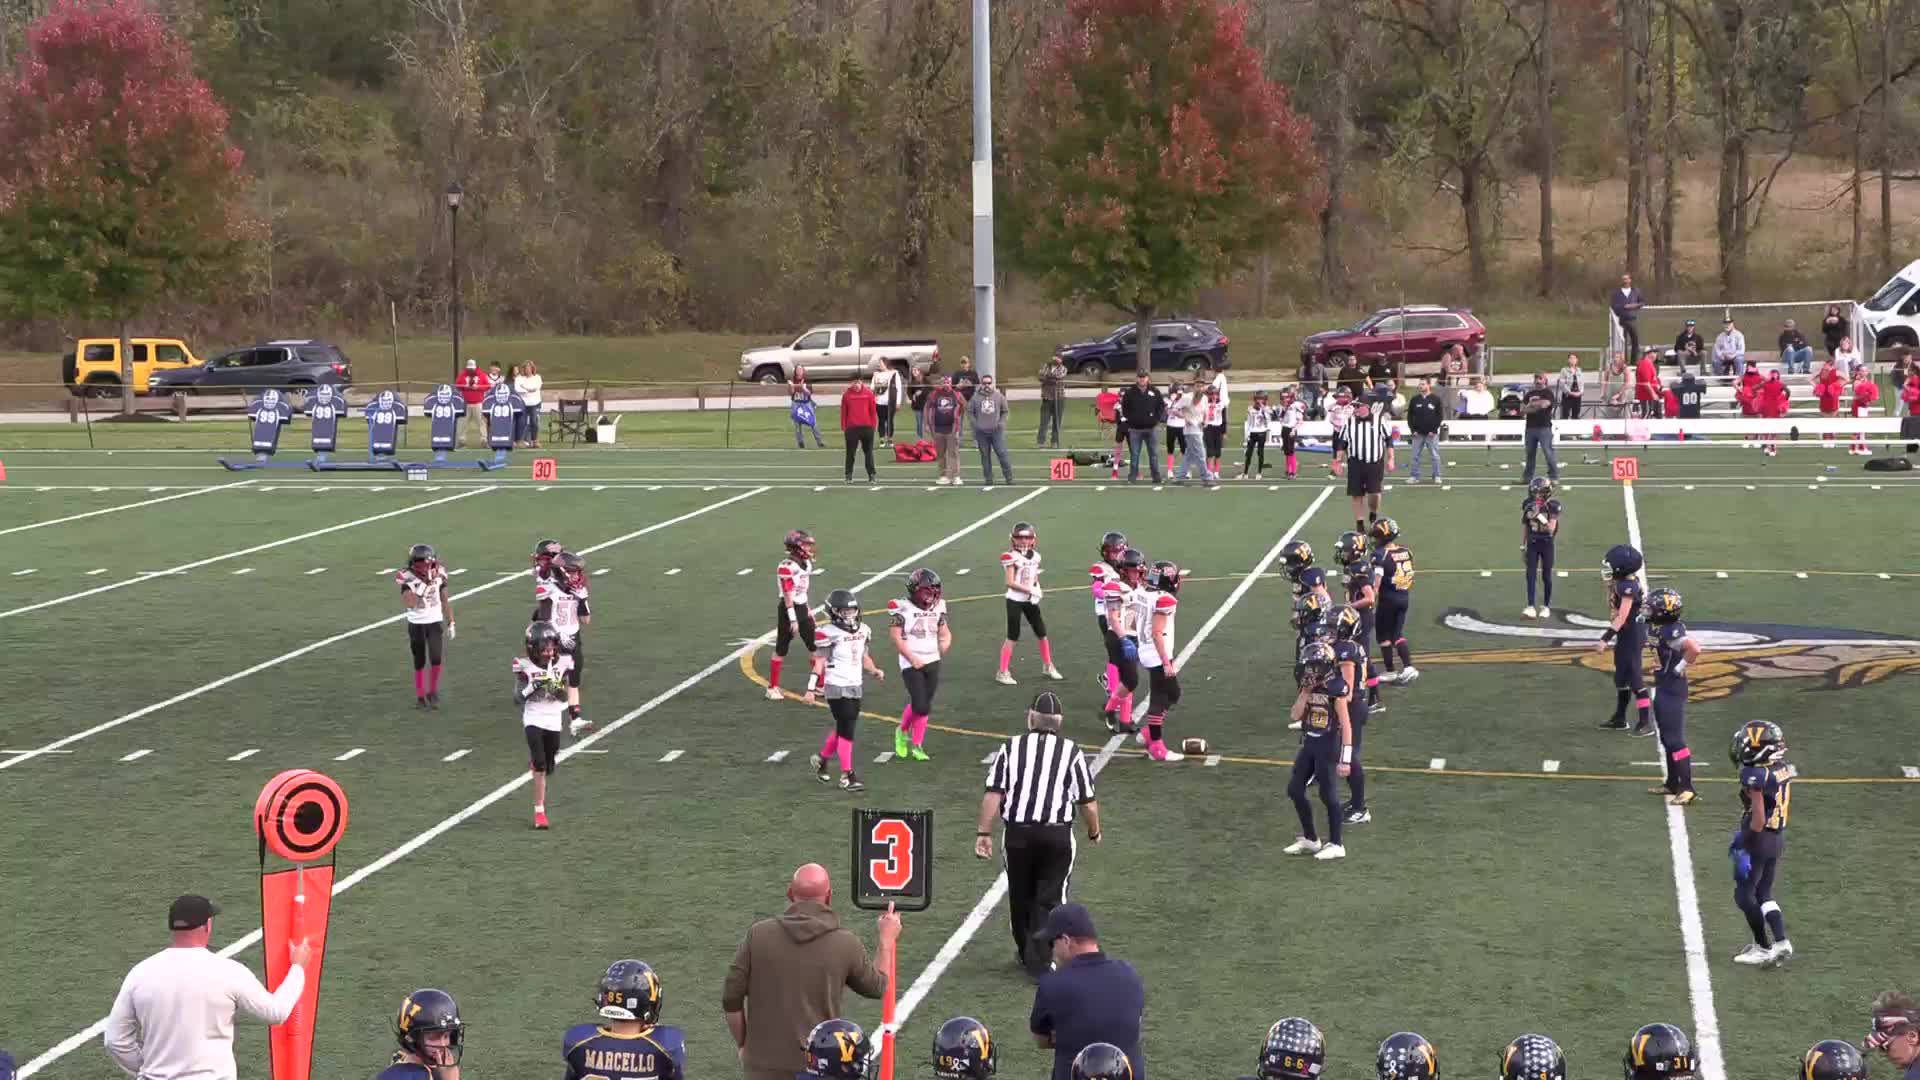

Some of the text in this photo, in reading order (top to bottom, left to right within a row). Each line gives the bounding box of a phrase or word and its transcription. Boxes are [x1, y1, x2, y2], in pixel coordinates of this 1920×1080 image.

[1683, 392, 1697, 405] 00
[260, 411, 275, 423] 99
[316, 406, 331, 418] 99
[436, 405, 450, 417] 99
[535, 461, 551, 478] 30
[1053, 462, 1070, 478] 40
[1616, 460, 1634, 477] 50
[1747, 727, 1765, 748] V
[870, 819, 914, 890] 3
[644, 971, 659, 1002] V
[608, 991, 623, 1004] 85
[400, 998, 421, 1033] V
[834, 1031, 859, 1062] V
[971, 1028, 990, 1060] V
[1632, 1034, 1651, 1066] V
[584, 1048, 656, 1073] MARCELLO
[1674, 1057, 1688, 1069] 31
